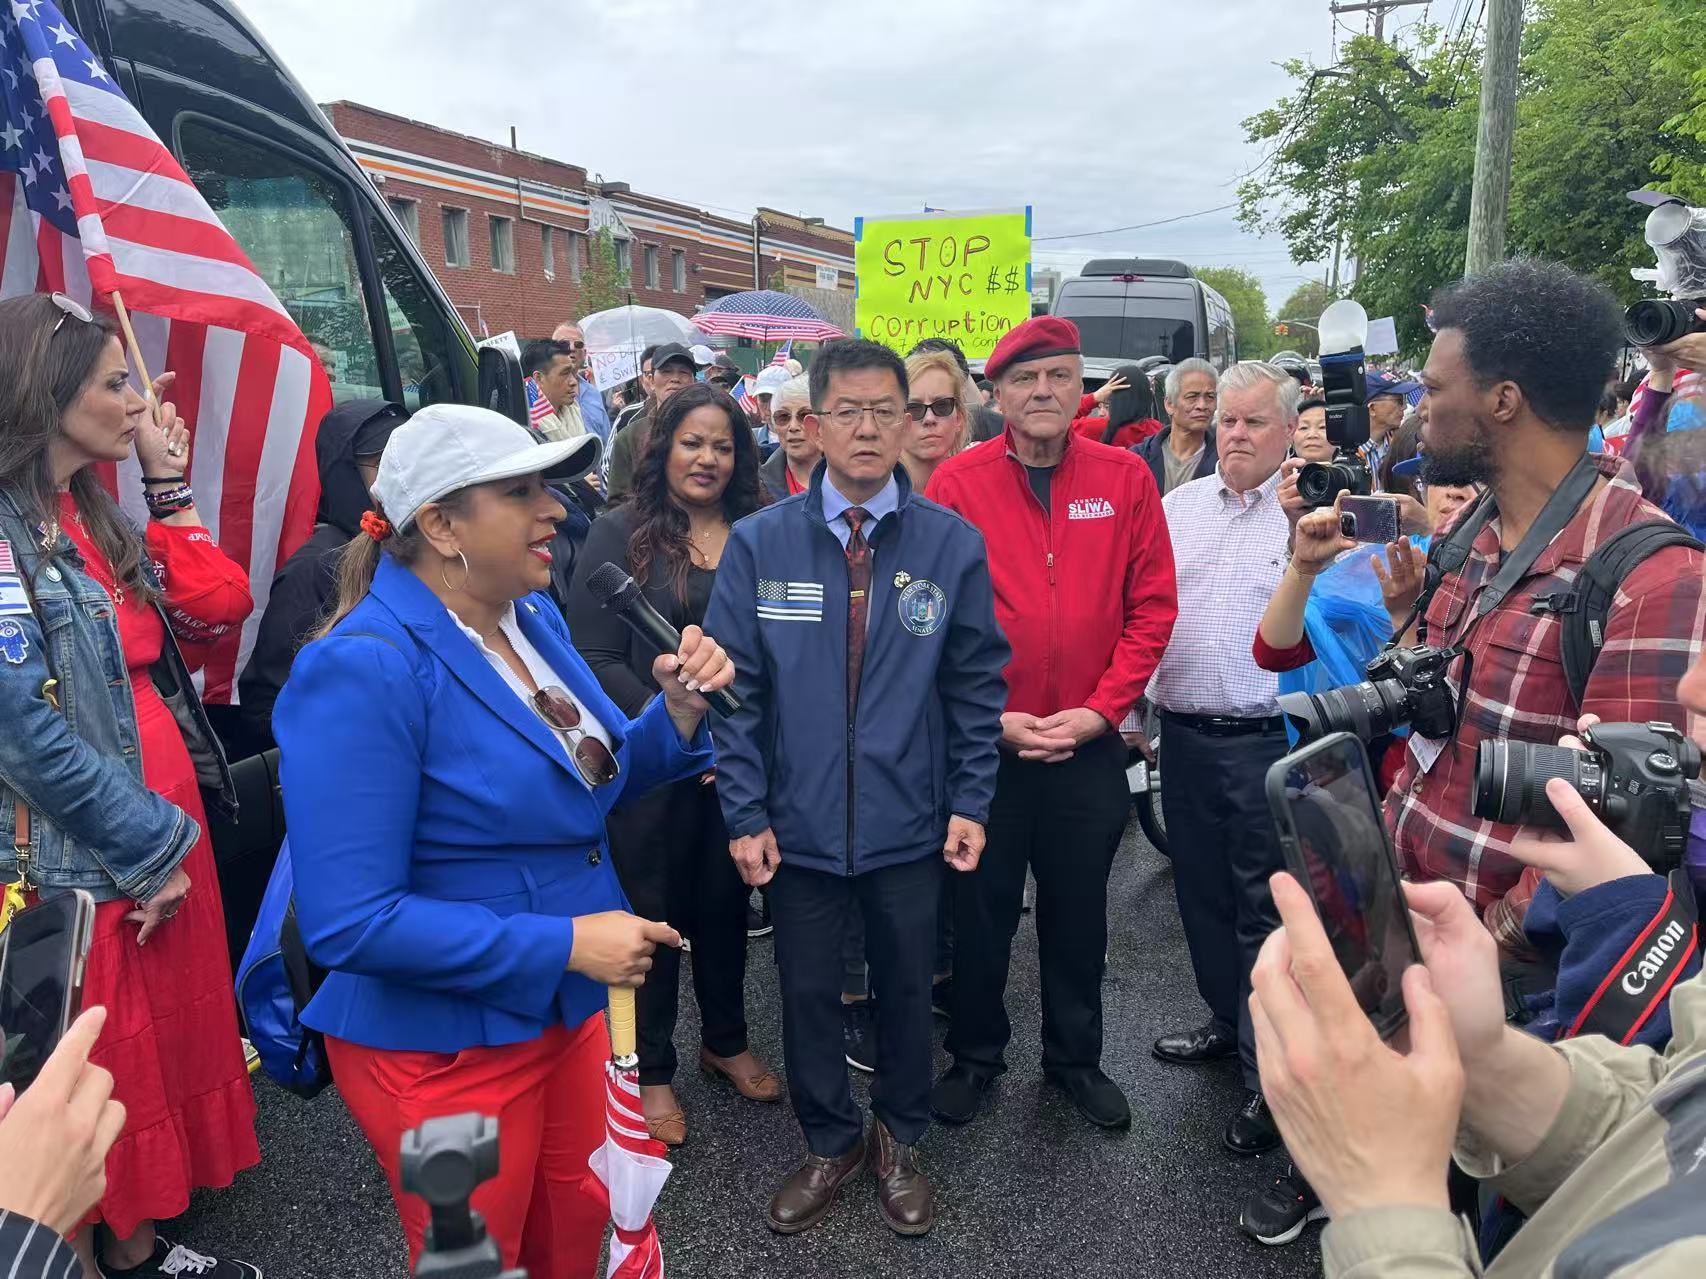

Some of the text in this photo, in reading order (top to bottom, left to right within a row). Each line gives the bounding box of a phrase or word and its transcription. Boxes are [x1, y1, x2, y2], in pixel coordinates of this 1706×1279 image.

[884, 235, 990, 277] STOP
[908, 265, 1020, 303] NYC $$
[1068, 500, 1114, 514] SLIWA
[1622, 920, 1685, 995] Canon
